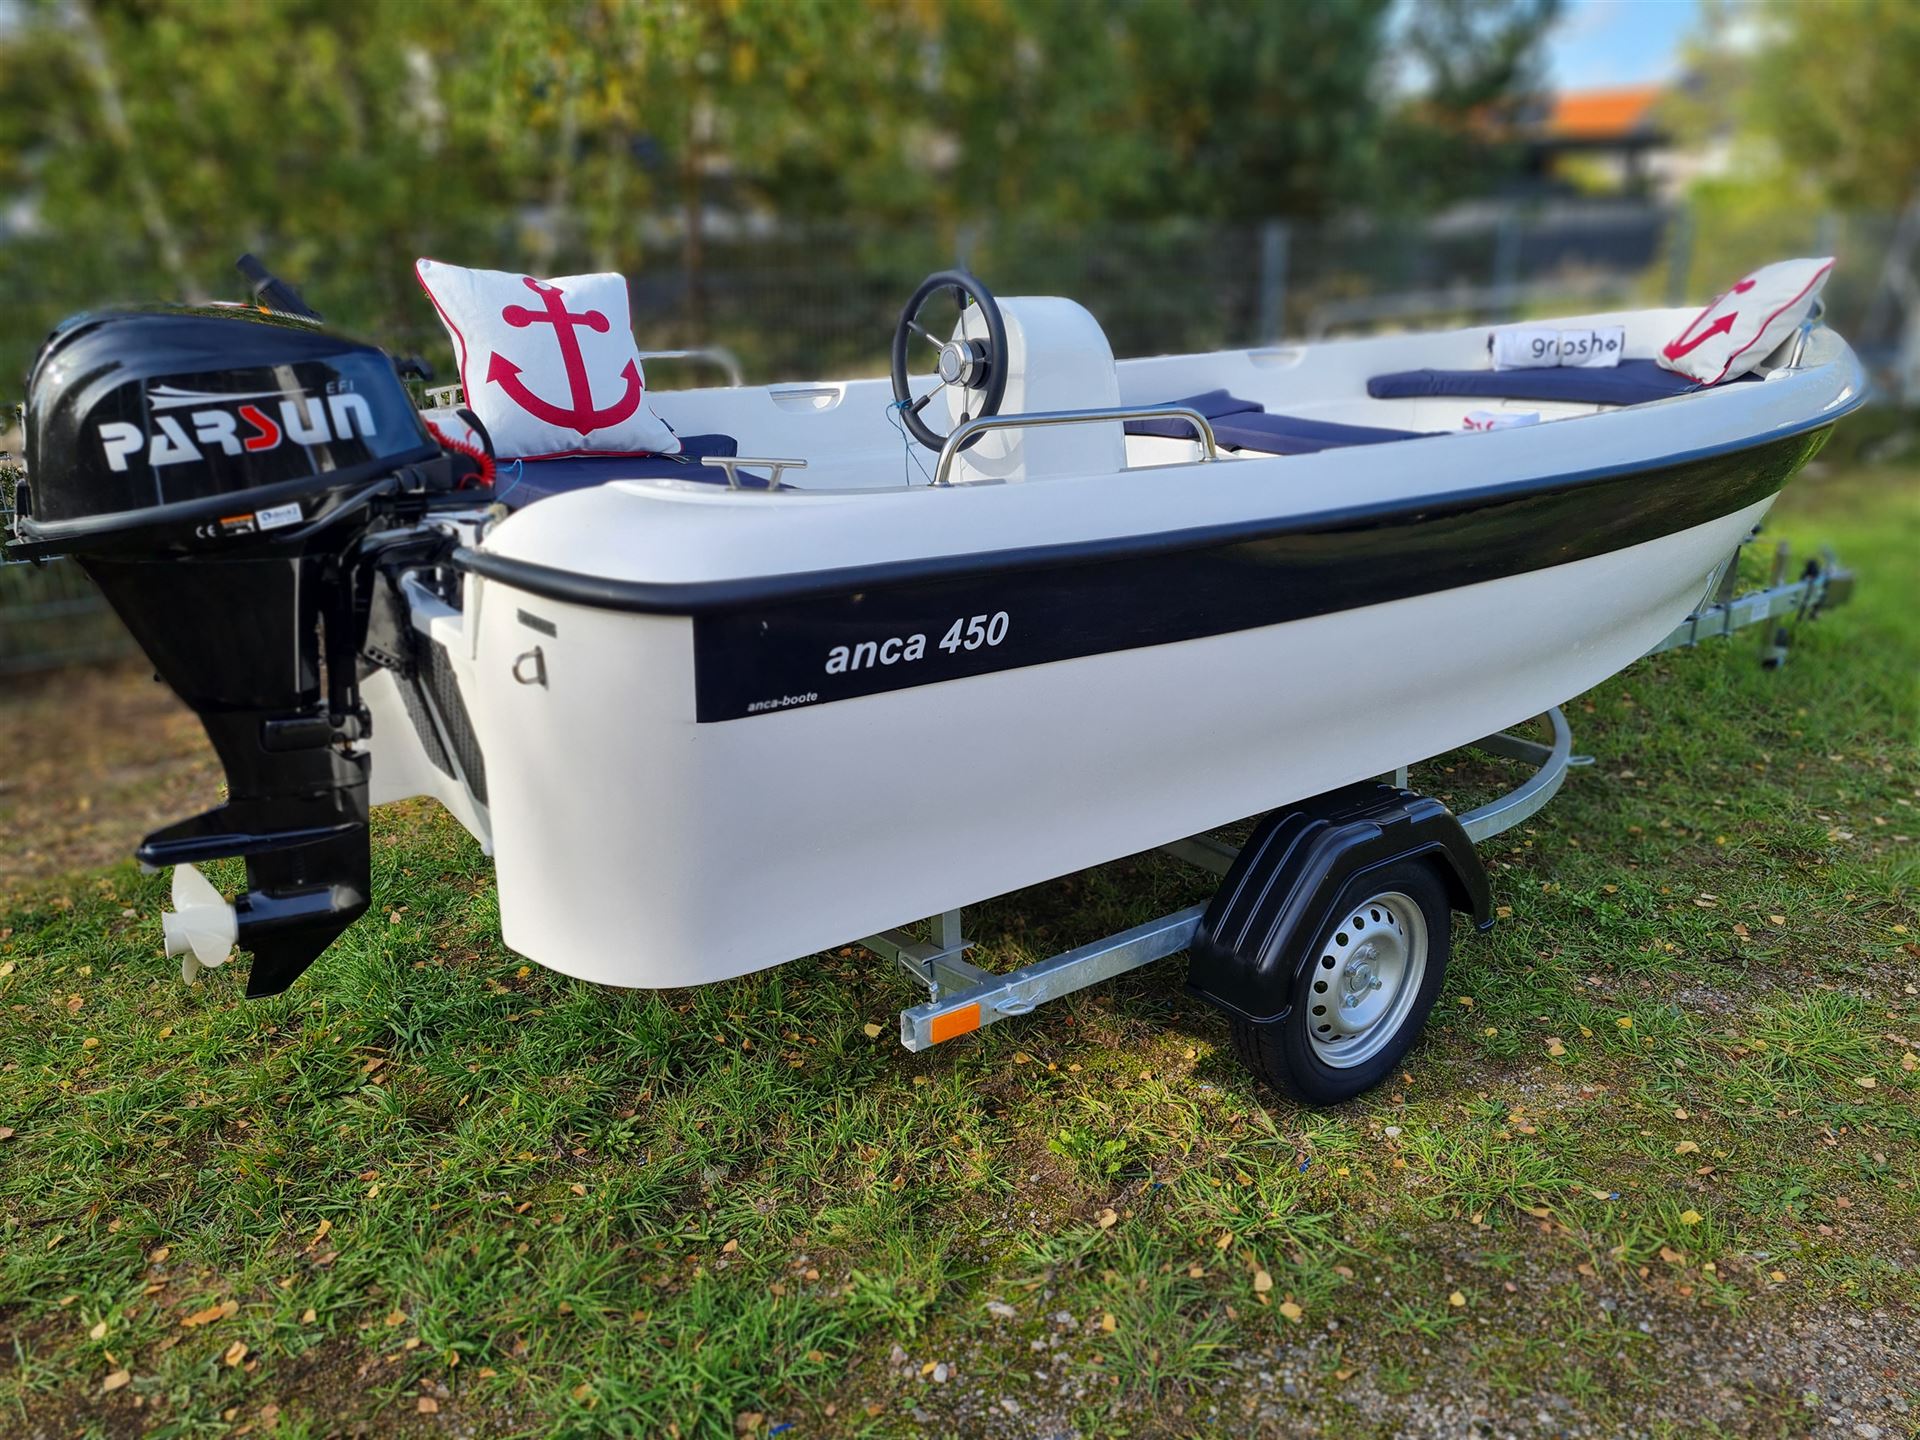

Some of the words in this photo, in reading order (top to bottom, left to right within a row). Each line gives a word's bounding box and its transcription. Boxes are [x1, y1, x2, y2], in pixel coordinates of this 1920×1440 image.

[326, 380, 354, 394] EFI
[99, 394, 376, 472] PARSUN
[825, 634, 926, 674] anca
[938, 611, 1009, 653] 450
[747, 692, 818, 712] anca-boote
